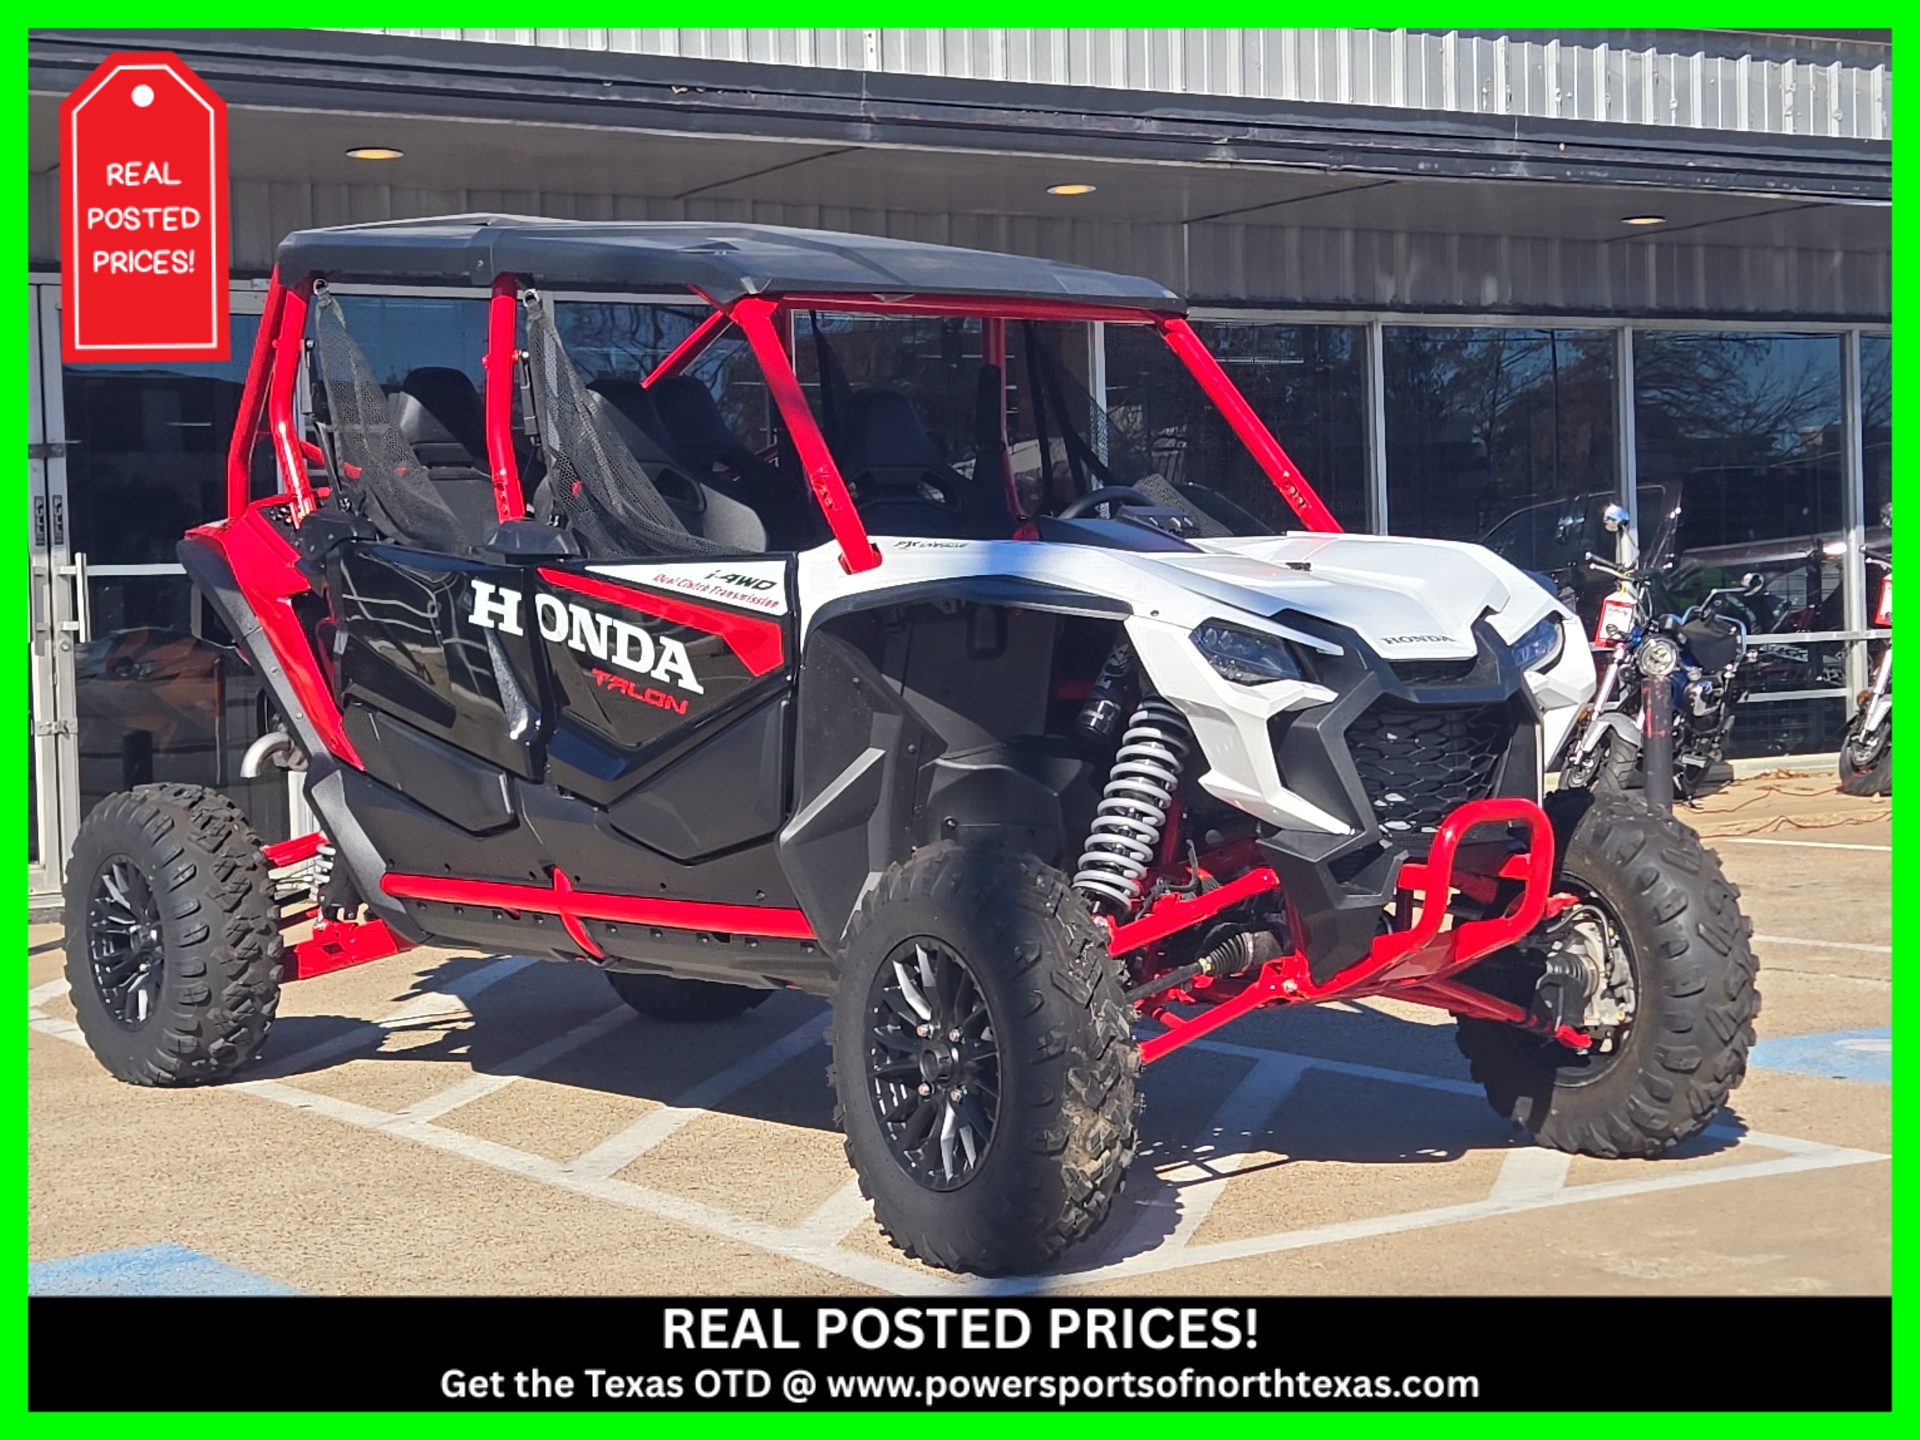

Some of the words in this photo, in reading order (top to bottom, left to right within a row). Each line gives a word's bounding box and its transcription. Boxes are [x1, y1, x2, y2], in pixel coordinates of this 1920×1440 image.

[652, 573, 681, 585] Dual
[709, 585, 780, 609] Transmission
[704, 569, 777, 591] i-4WD
[468, 579, 704, 695] HONDA
[1380, 634, 1457, 645] HONDA
[591, 667, 689, 715] TALON
